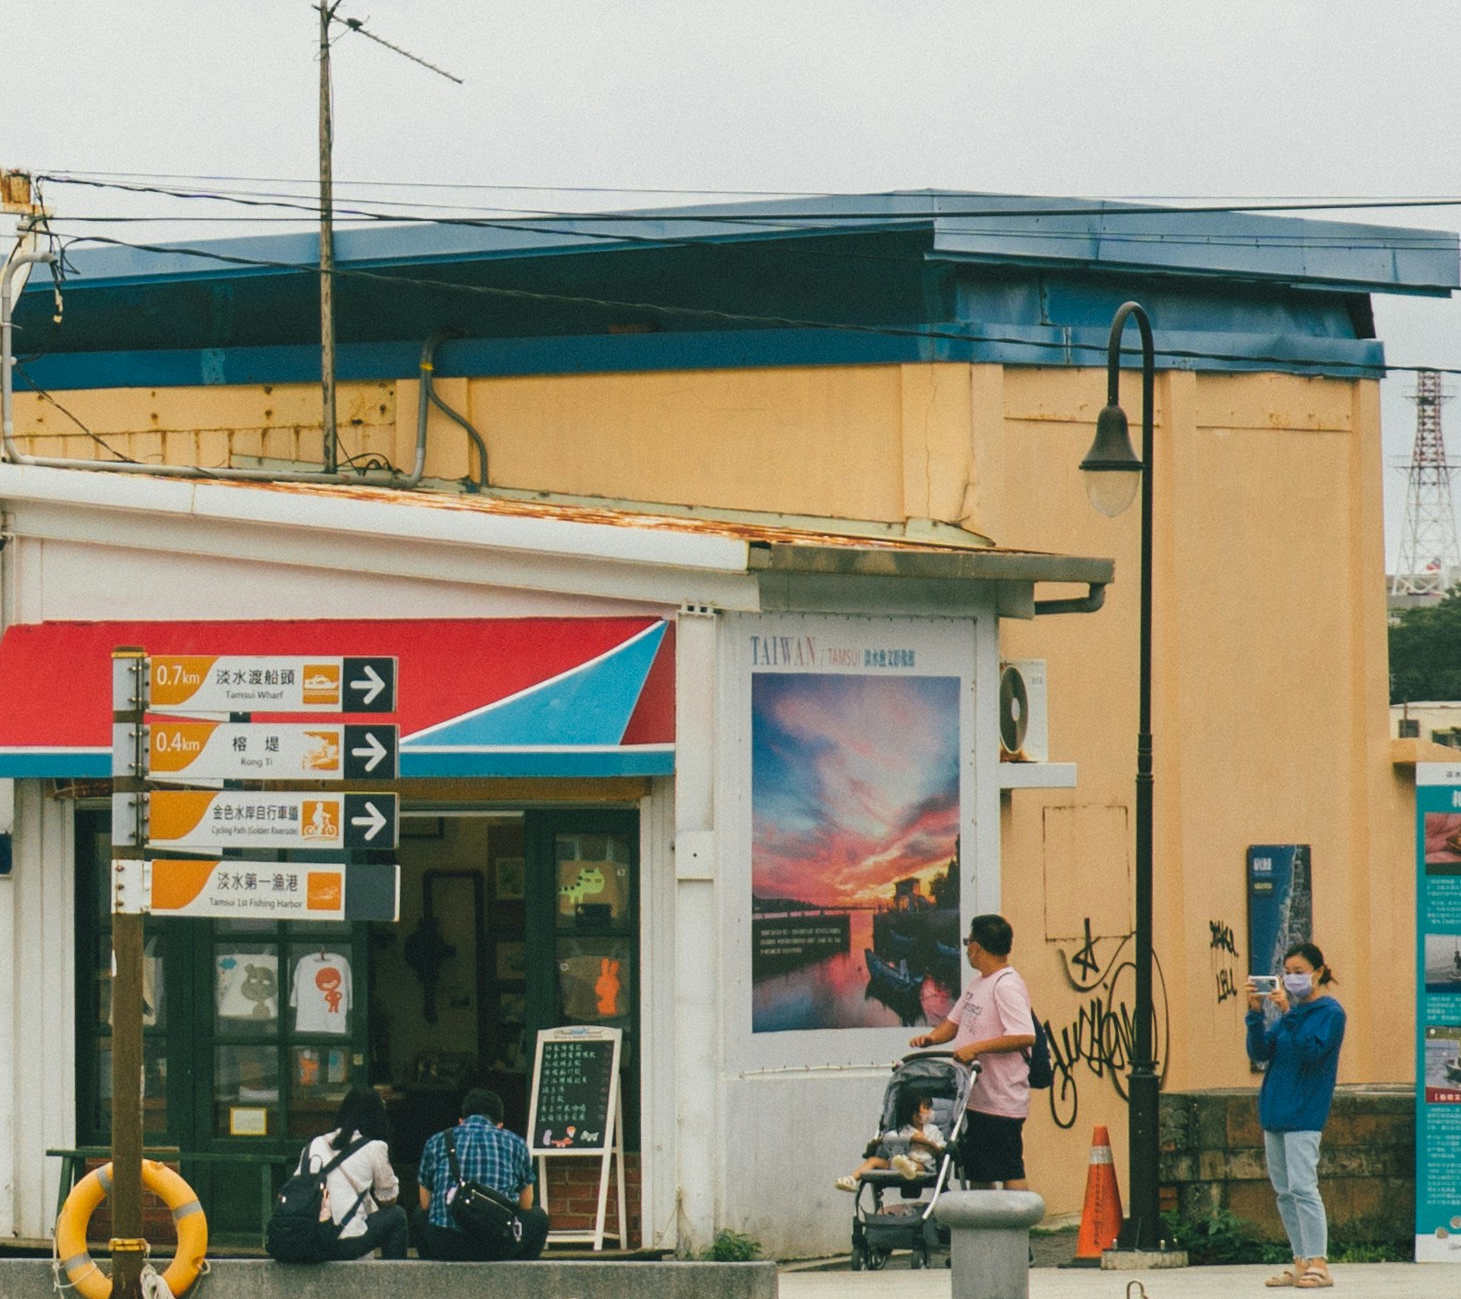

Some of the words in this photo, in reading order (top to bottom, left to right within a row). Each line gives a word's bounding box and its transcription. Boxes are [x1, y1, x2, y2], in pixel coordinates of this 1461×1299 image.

[751, 636, 816, 665] TAIWAN
[828, 648, 861, 666] TAMSUI
[157, 665, 200, 685] 0.7km
[216, 669, 296, 685] 淡水渡船頭
[226, 690, 255, 699] Tamsui
[257, 690, 283, 699] Wharf
[156, 732, 200, 751] 0.4km
[241, 758, 263, 768] Rong
[266, 758, 273, 766] Ti
[213, 804, 298, 821] 金色水岸自行車道
[211, 826, 232, 835] Cycling
[233, 826, 246, 834] Path
[217, 872, 298, 892] 淡水第一漁港
[210, 898, 235, 906] Tamsui
[237, 898, 248, 907] 1st
[250, 899, 275, 909] Fishing
[277, 899, 302, 908] Harbor
